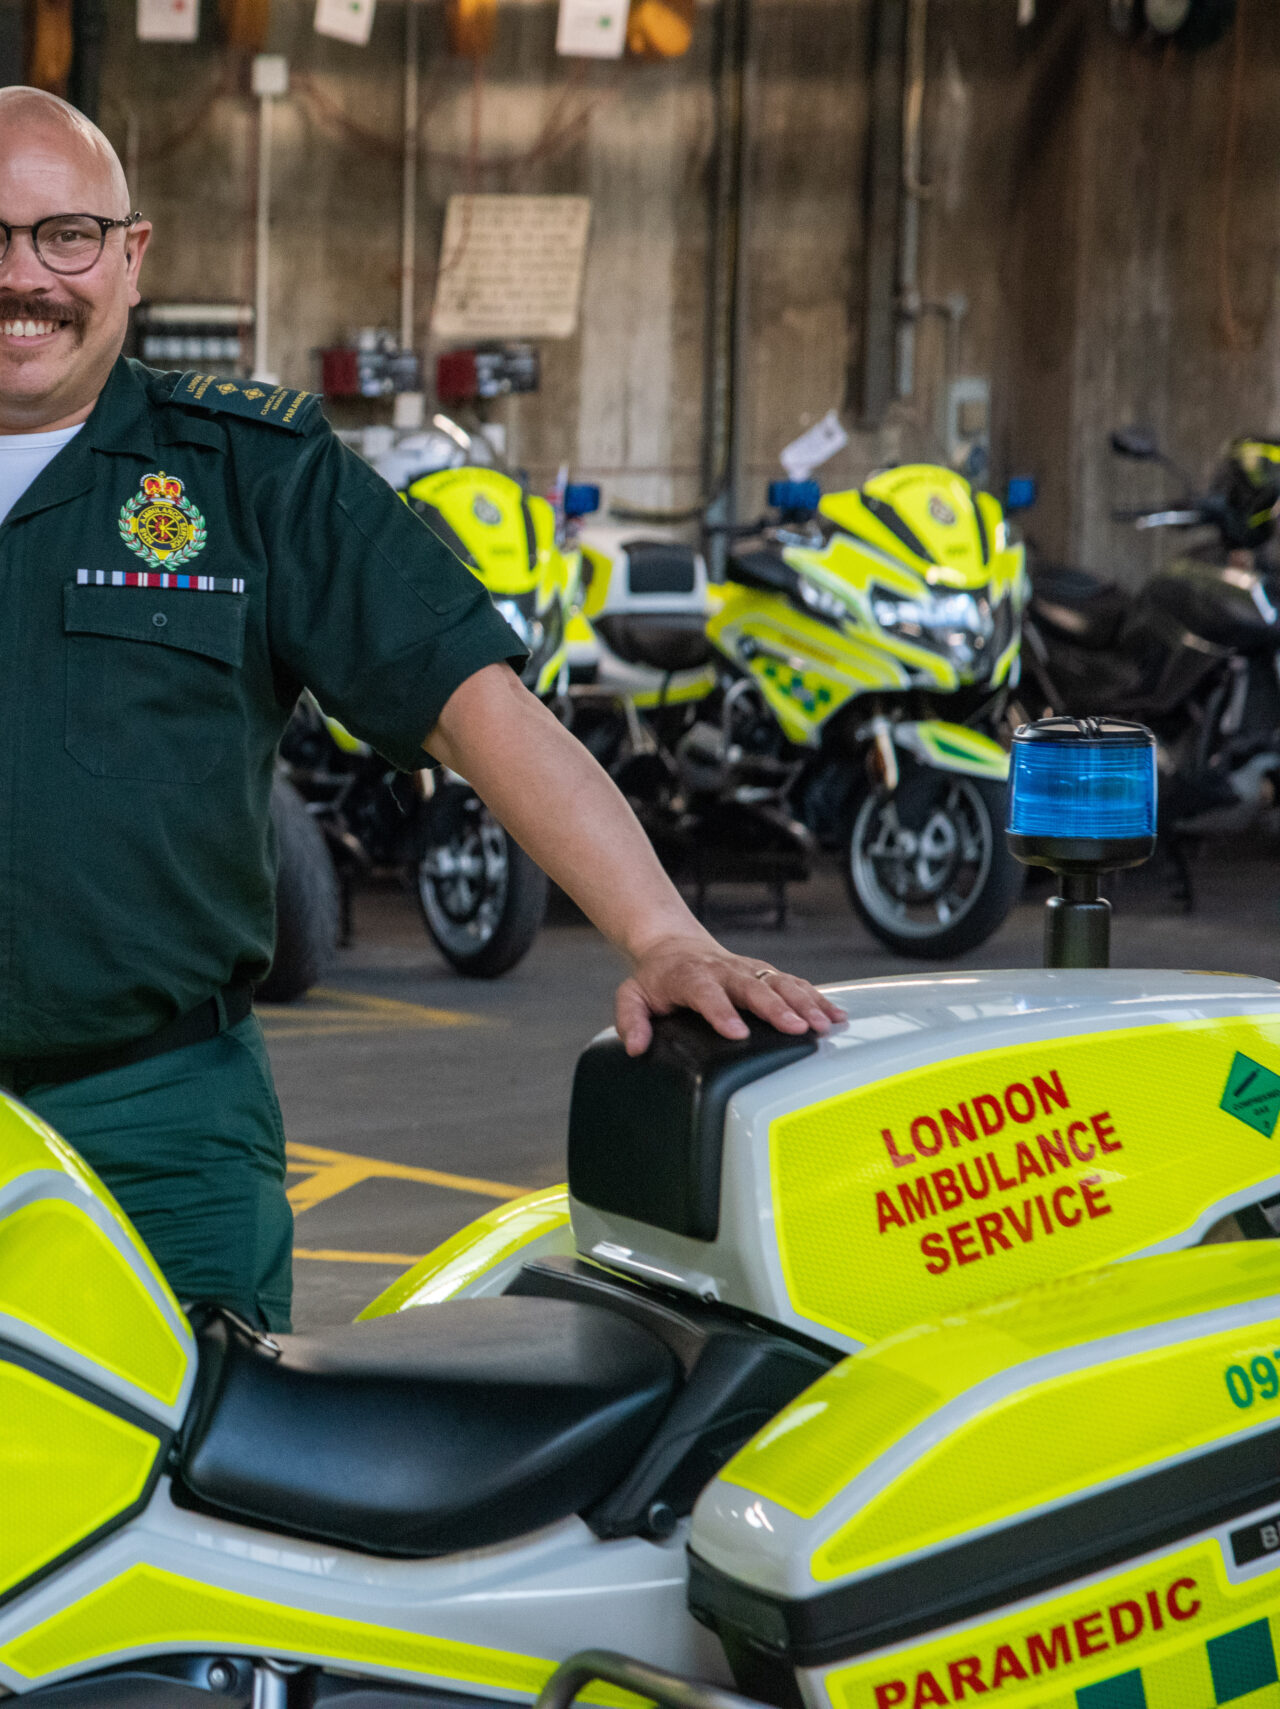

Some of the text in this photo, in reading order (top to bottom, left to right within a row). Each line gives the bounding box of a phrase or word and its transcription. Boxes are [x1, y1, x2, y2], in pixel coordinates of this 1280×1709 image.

[881, 1069, 1071, 1169] LONDON
[875, 1111, 1123, 1235] AMBULANCE
[920, 1174, 1112, 1275] SERVICE
[1225, 1348, 1280, 1409] 09
[874, 1577, 1201, 1709] PARAMEDIC
